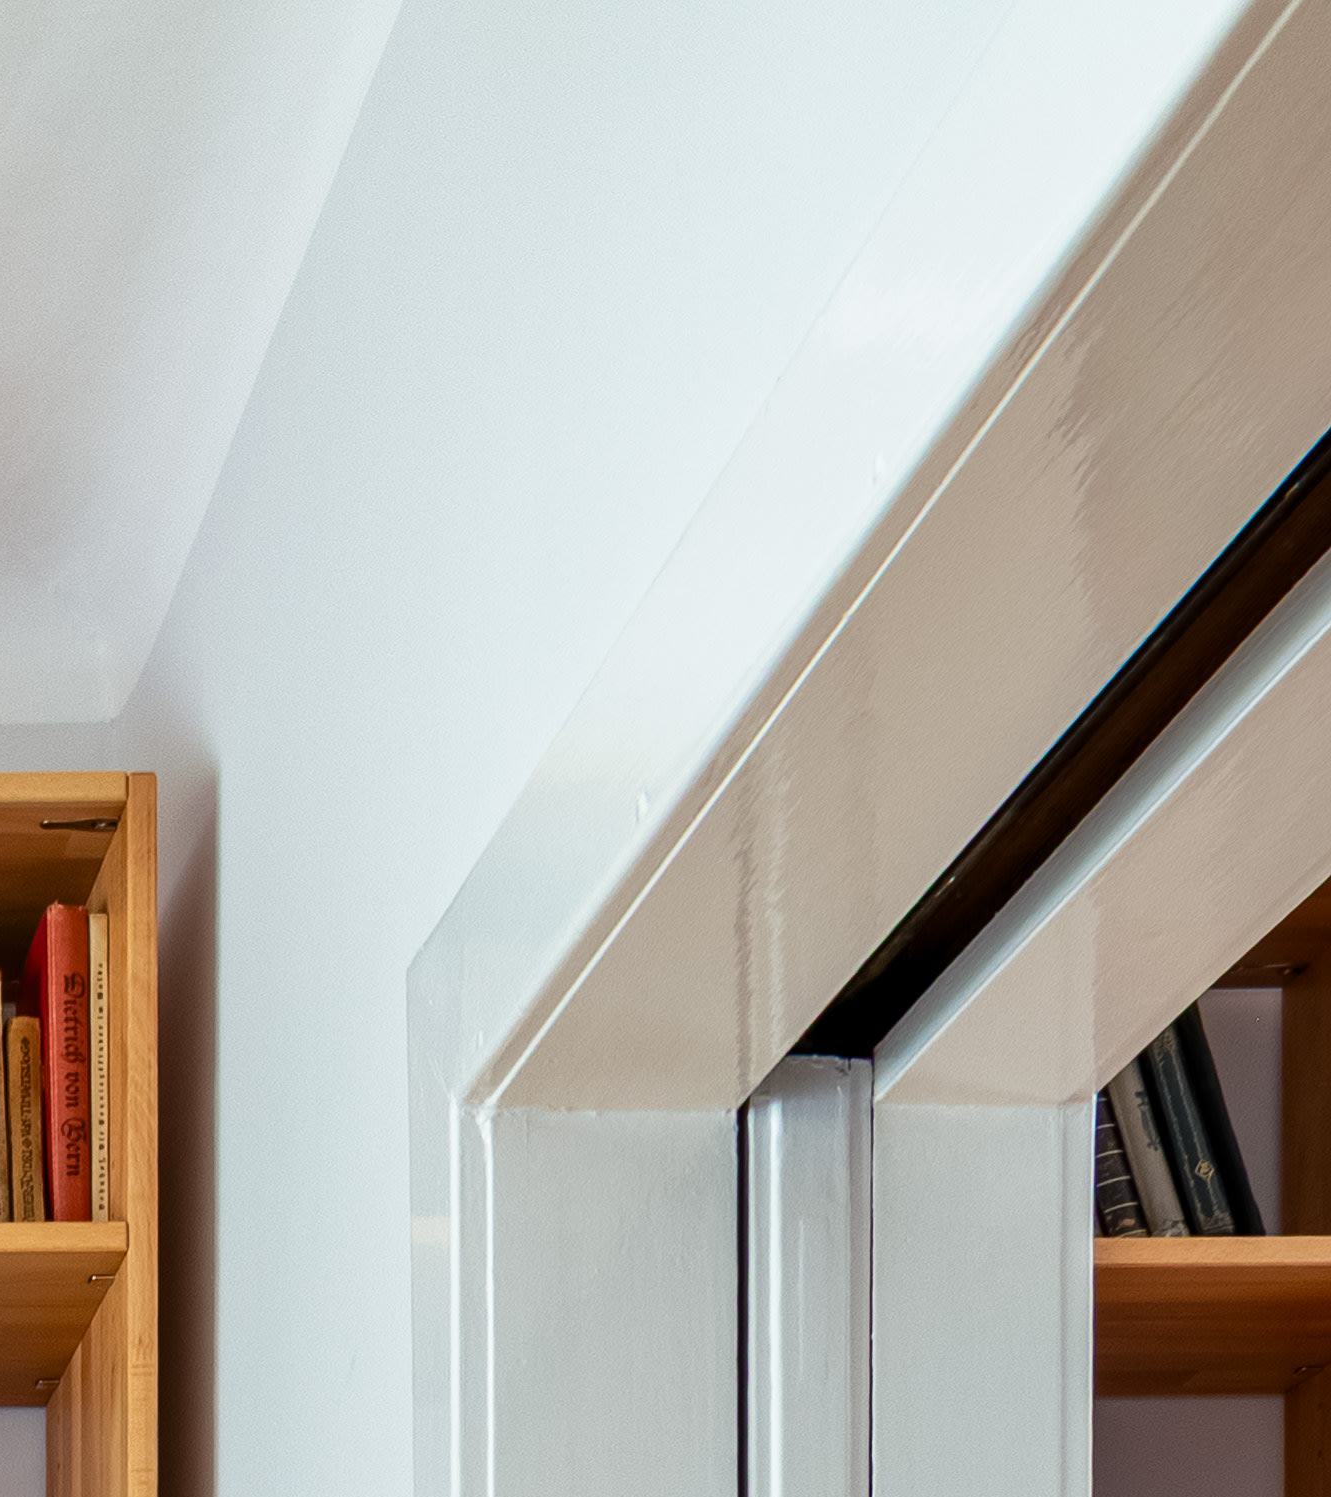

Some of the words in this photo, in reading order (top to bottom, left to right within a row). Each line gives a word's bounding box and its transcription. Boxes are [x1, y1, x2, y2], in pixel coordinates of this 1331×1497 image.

[63, 972, 86, 1063] Dietrich
[65, 1072, 80, 1107] von
[61, 1117, 87, 1177] Bern
